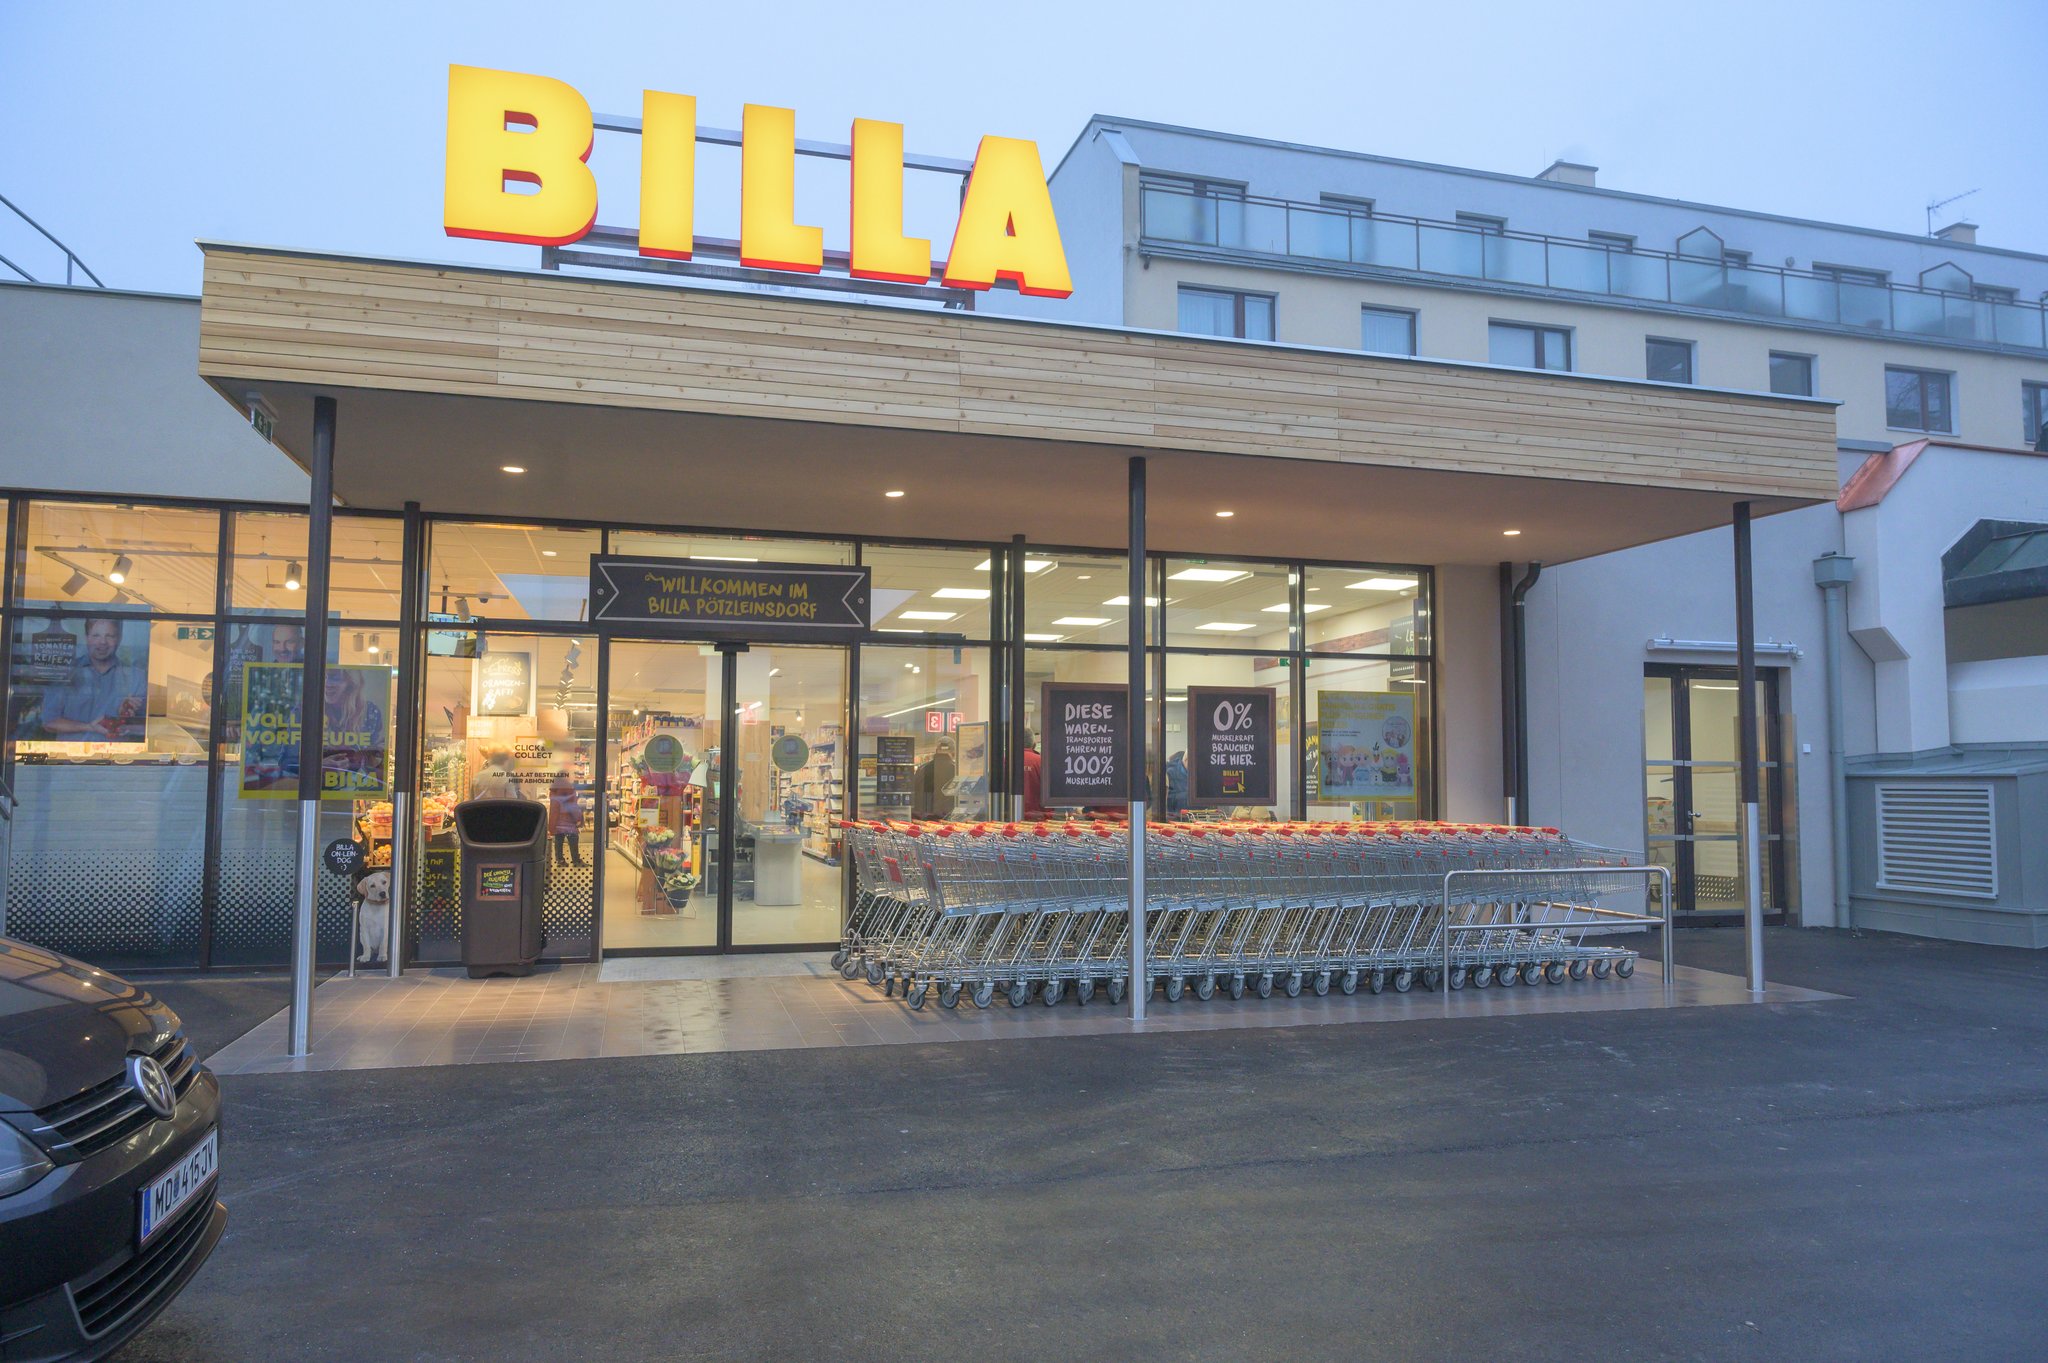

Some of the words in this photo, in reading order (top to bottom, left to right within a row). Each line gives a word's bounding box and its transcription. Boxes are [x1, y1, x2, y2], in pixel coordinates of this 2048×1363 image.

[443, 63, 1073, 299] BILLA
[645, 572, 783, 598] WILLKOMMEN
[789, 581, 808, 600] IM
[648, 596, 690, 615] BILLA
[696, 597, 817, 620] PÖTZLEINSDORF
[34, 642, 74, 650] TOMATEN
[34, 652, 72, 665] REIFEN
[1064, 702, 1113, 721] DIESE
[1213, 700, 1253, 732] 0%
[1064, 722, 1114, 735] WAREN-
[245, 730, 372, 746] VORFEUDE
[1066, 736, 1112, 744] TRANSPORTER
[1211, 734, 1255, 742] MUSKELKRAFT
[1065, 745, 1097, 754] FAHREN
[1098, 745, 1112, 754] MIT
[1211, 743, 1255, 753] BRAUCHEN
[1064, 755, 1114, 775] 100%
[1210, 754, 1227, 765] SIE
[1229, 754, 1257, 766] HIER.
[325, 771, 379, 788] BILLA
[1065, 776, 1113, 786] MUSKELKRAFT.
[155, 1178, 173, 1220] MD
[181, 1152, 200, 1194] 415
[201, 1138, 214, 1176] JV
